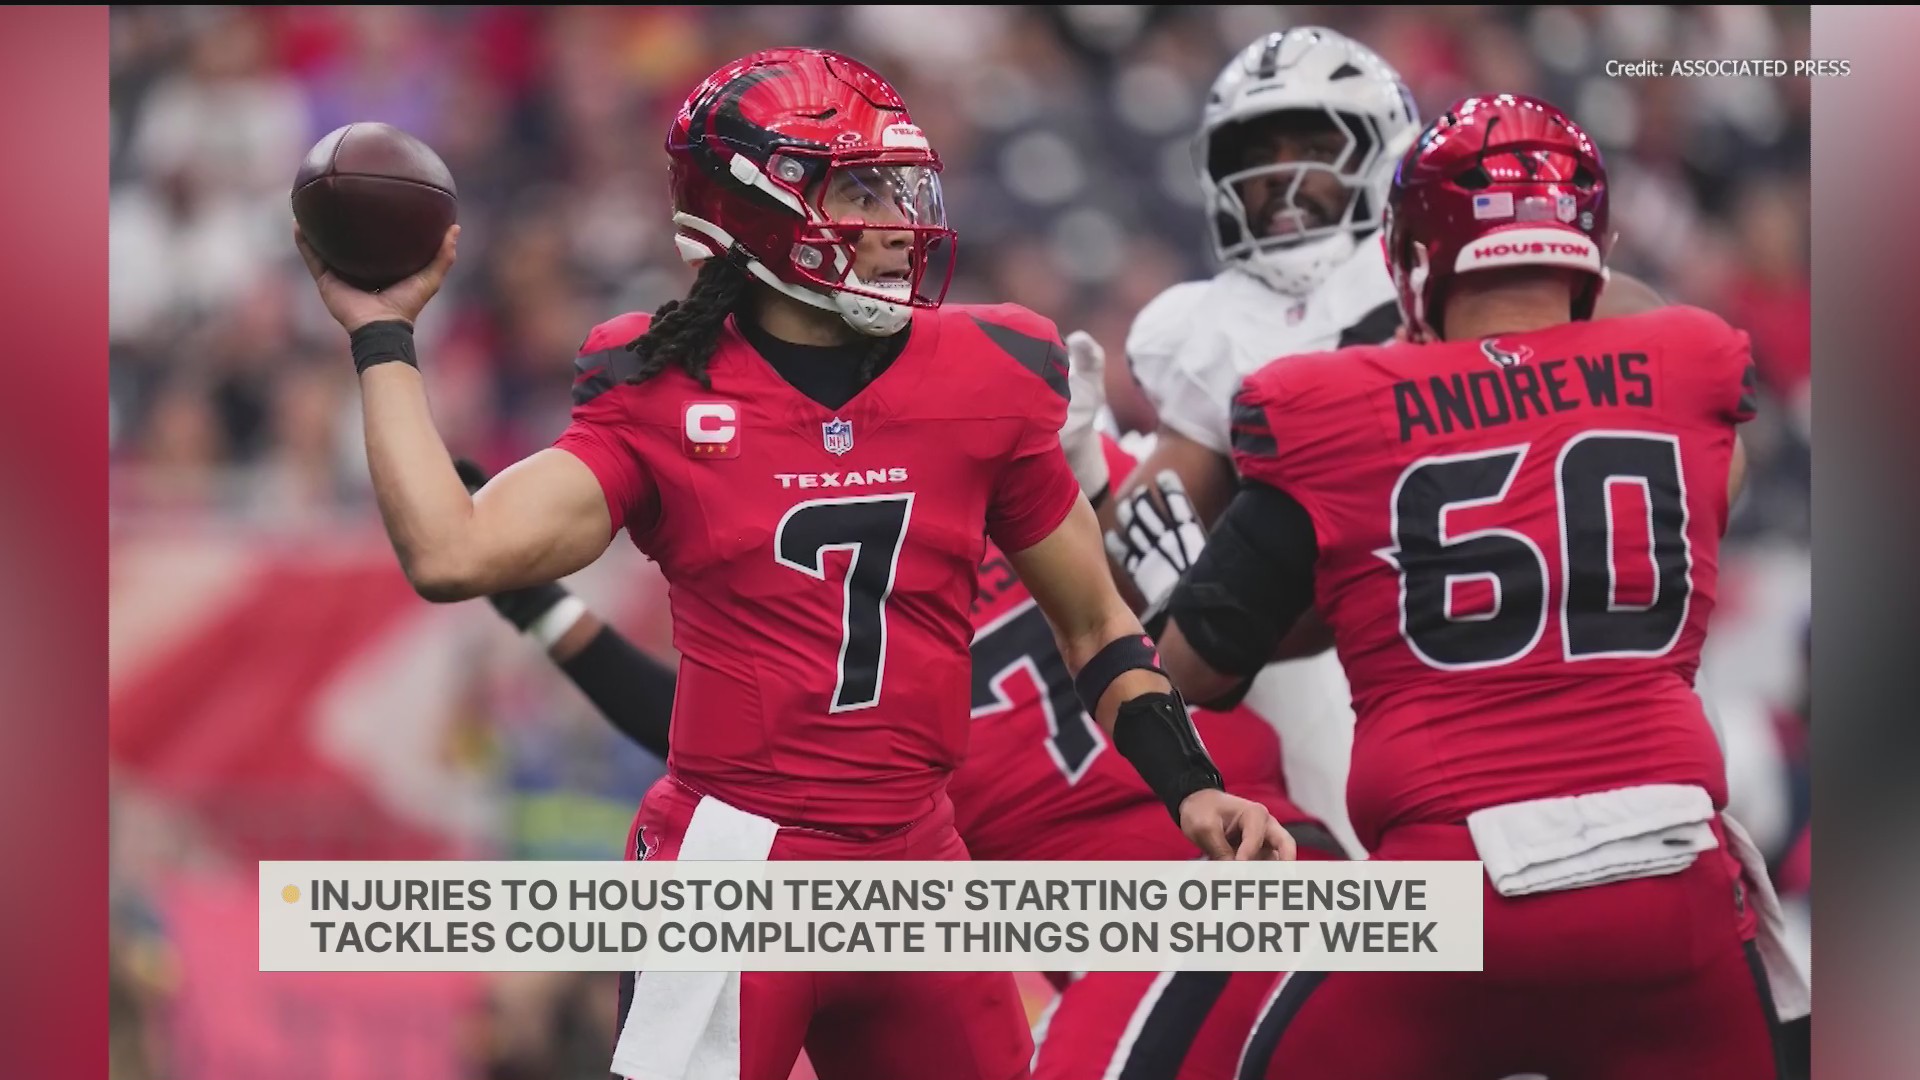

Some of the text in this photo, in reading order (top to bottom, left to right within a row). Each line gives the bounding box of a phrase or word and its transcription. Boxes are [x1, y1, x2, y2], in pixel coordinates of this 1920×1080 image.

[1474, 241, 1589, 260] HOUSTON
[1392, 352, 1652, 443] ANDREWS
[685, 404, 737, 443] C
[828, 435, 850, 448] NFL
[773, 467, 908, 489] TEXANS
[1371, 429, 1694, 671] 60
[774, 491, 916, 715] 7
